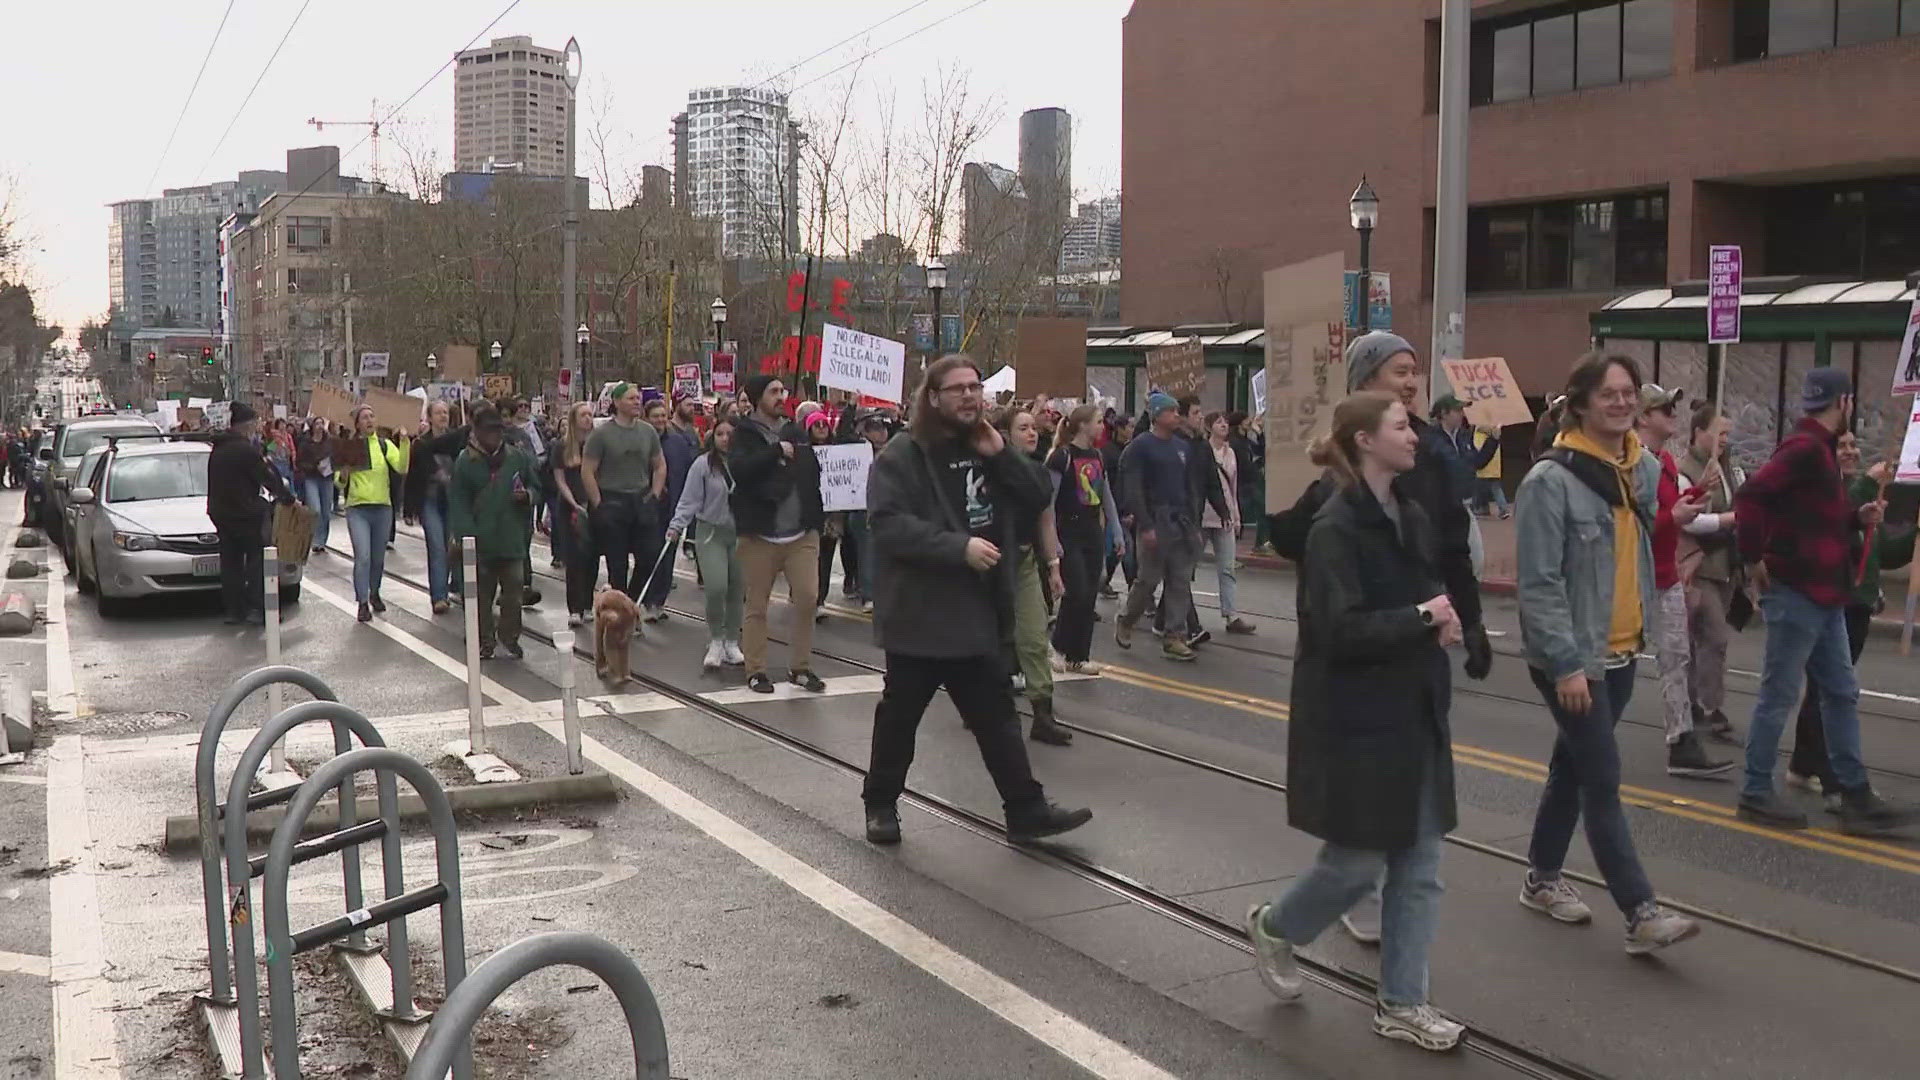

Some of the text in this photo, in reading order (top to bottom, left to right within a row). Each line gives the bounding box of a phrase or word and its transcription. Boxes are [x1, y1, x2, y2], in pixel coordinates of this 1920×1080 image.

[836, 329, 881, 350] NO ONE IS
[1327, 321, 1344, 365] ICE
[832, 343, 875, 363] ILLEGAL
[877, 354, 890, 368] ON
[829, 358, 862, 379] STOLEN
[1450, 362, 1504, 382] FUCK
[1464, 383, 1507, 401] ICE
[827, 473, 852, 487] KNOW
